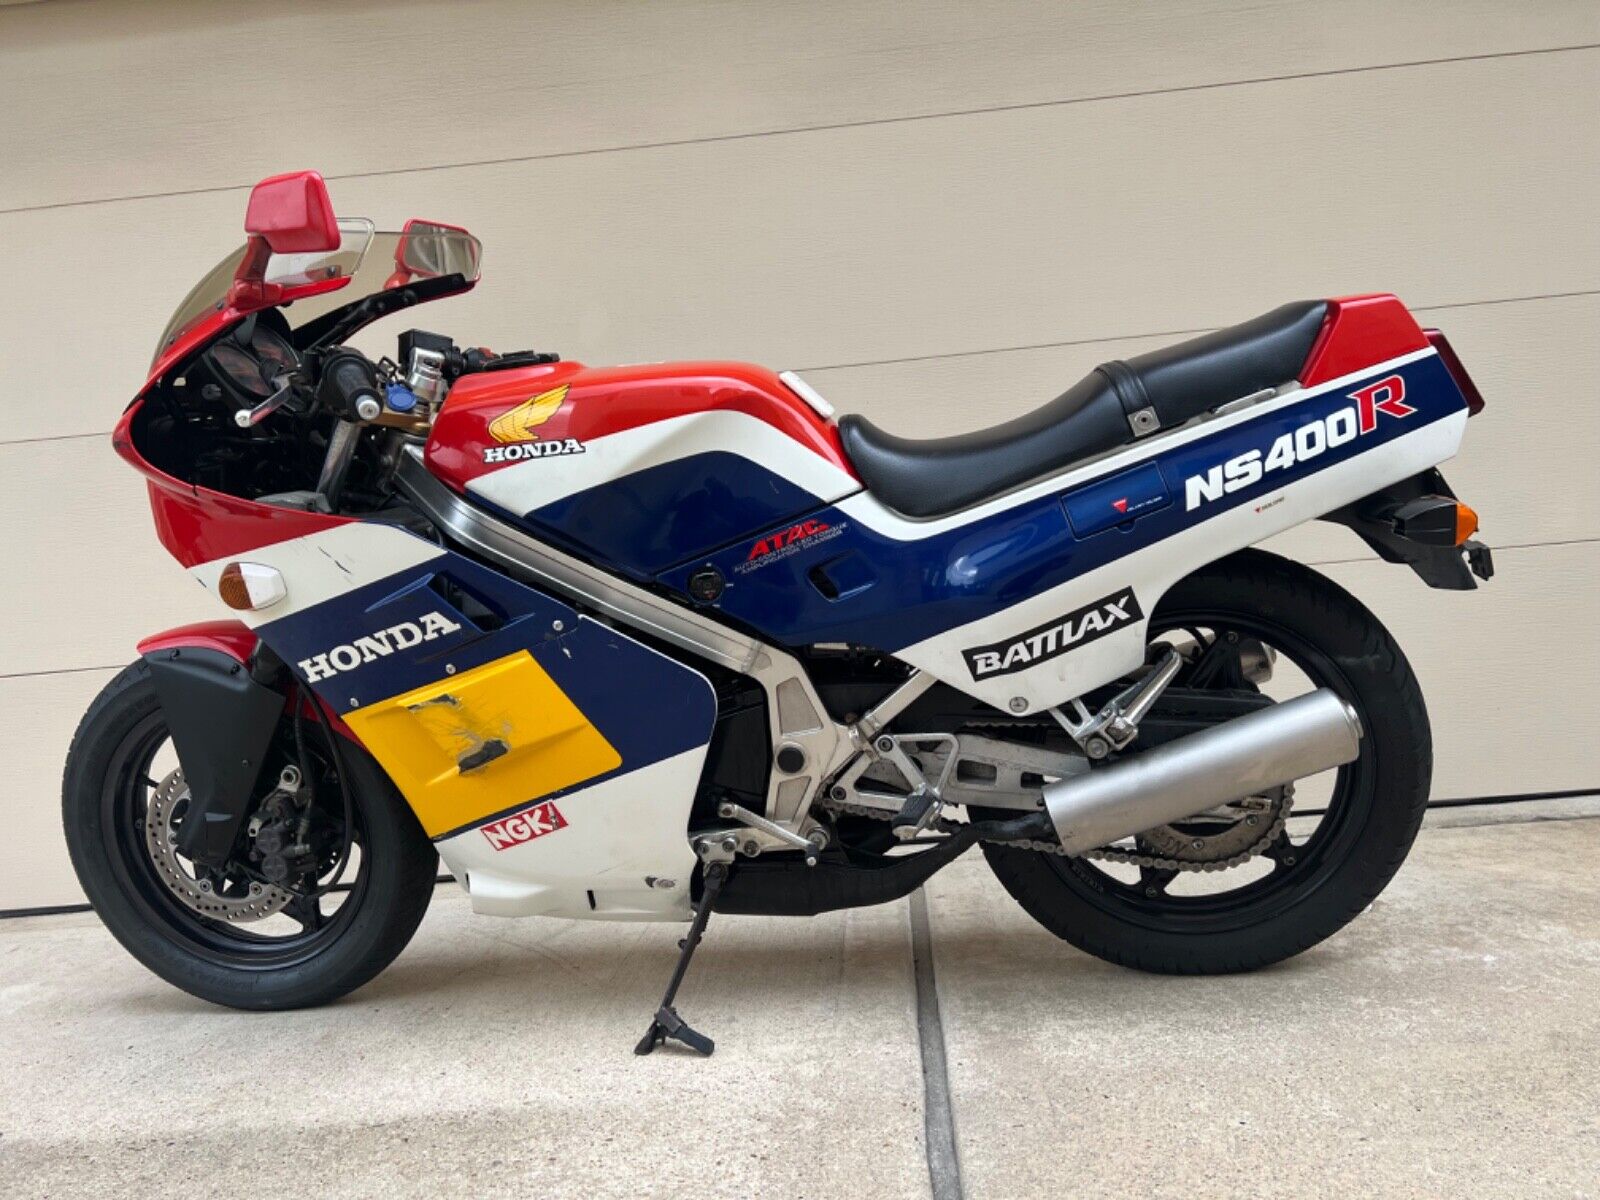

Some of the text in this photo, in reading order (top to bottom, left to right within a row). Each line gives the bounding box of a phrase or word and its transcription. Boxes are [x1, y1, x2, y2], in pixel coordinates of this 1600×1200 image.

[484, 438, 587, 463] HONDA
[1185, 374, 1418, 512] NS400R
[748, 519, 829, 561] ATAC
[297, 611, 462, 683] HONDA
[972, 595, 1132, 675] BATTLAX
[483, 808, 553, 849] NGK
